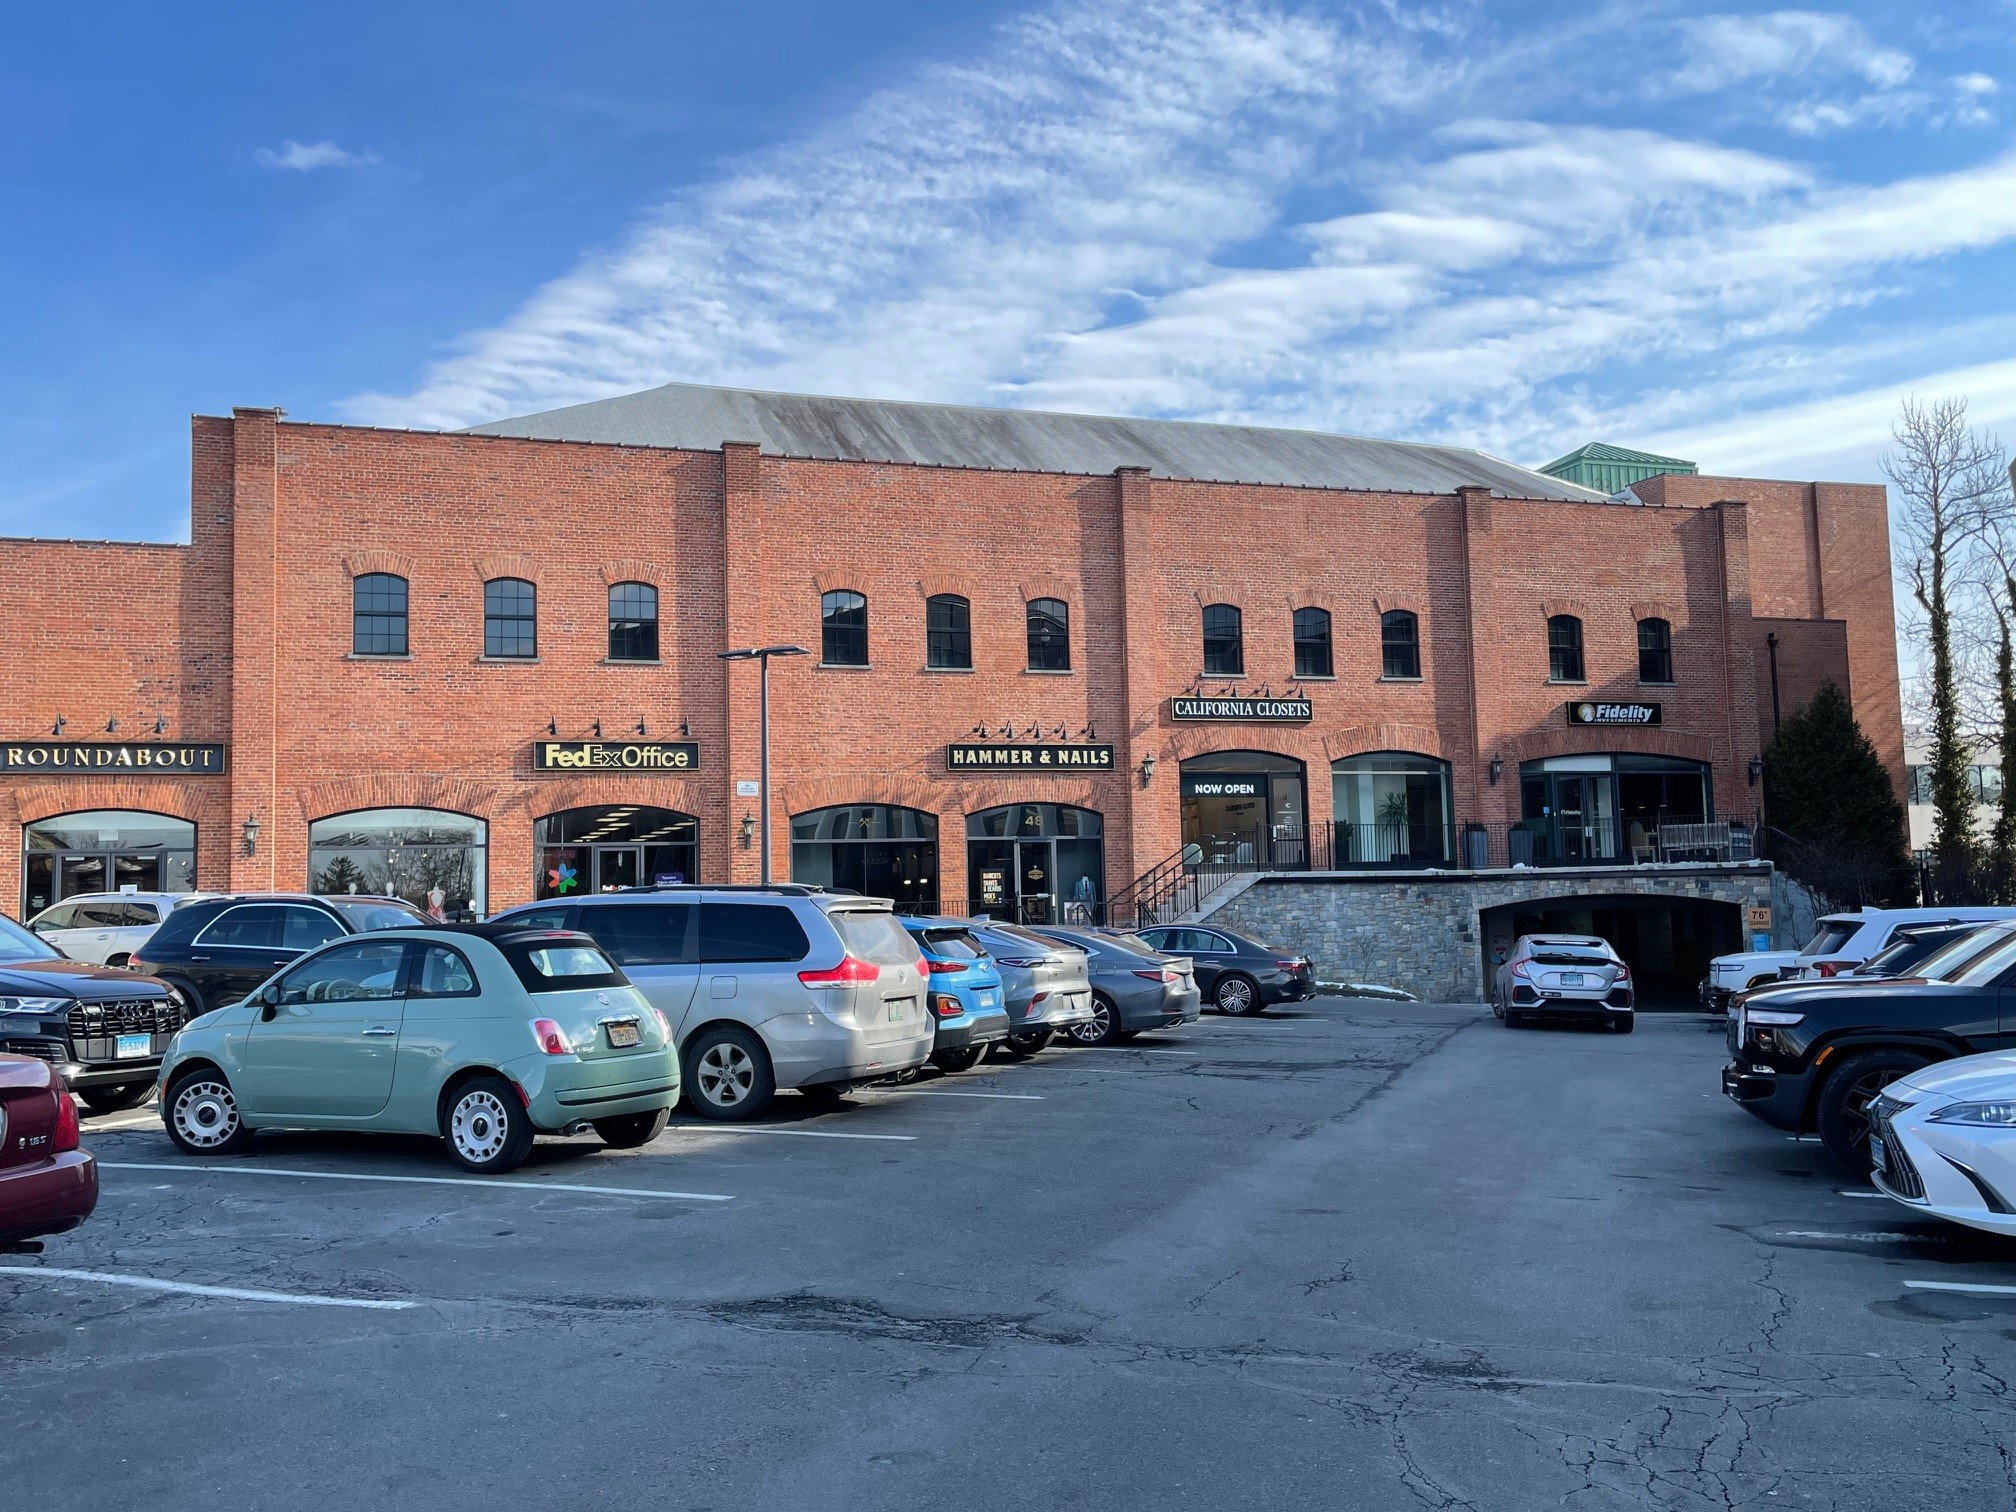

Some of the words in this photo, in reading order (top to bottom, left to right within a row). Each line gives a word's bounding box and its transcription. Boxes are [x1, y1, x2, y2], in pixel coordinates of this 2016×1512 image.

[1175, 701, 1253, 716] CALIFORNIA
[1256, 702, 1310, 716] CLOSETS
[1596, 704, 1654, 722] Fidelity
[7, 747, 213, 766] ROUNDABOUT
[545, 743, 622, 767] FedEx
[621, 745, 689, 767] Office
[953, 750, 1033, 764] HAMMER
[1039, 750, 1051, 764] &
[1058, 750, 1109, 764] NAILS
[1194, 784, 1222, 794] NOW
[1224, 784, 1255, 794] OPEN
[1025, 815, 1044, 826] 48
[552, 850, 576, 859] OPEN
